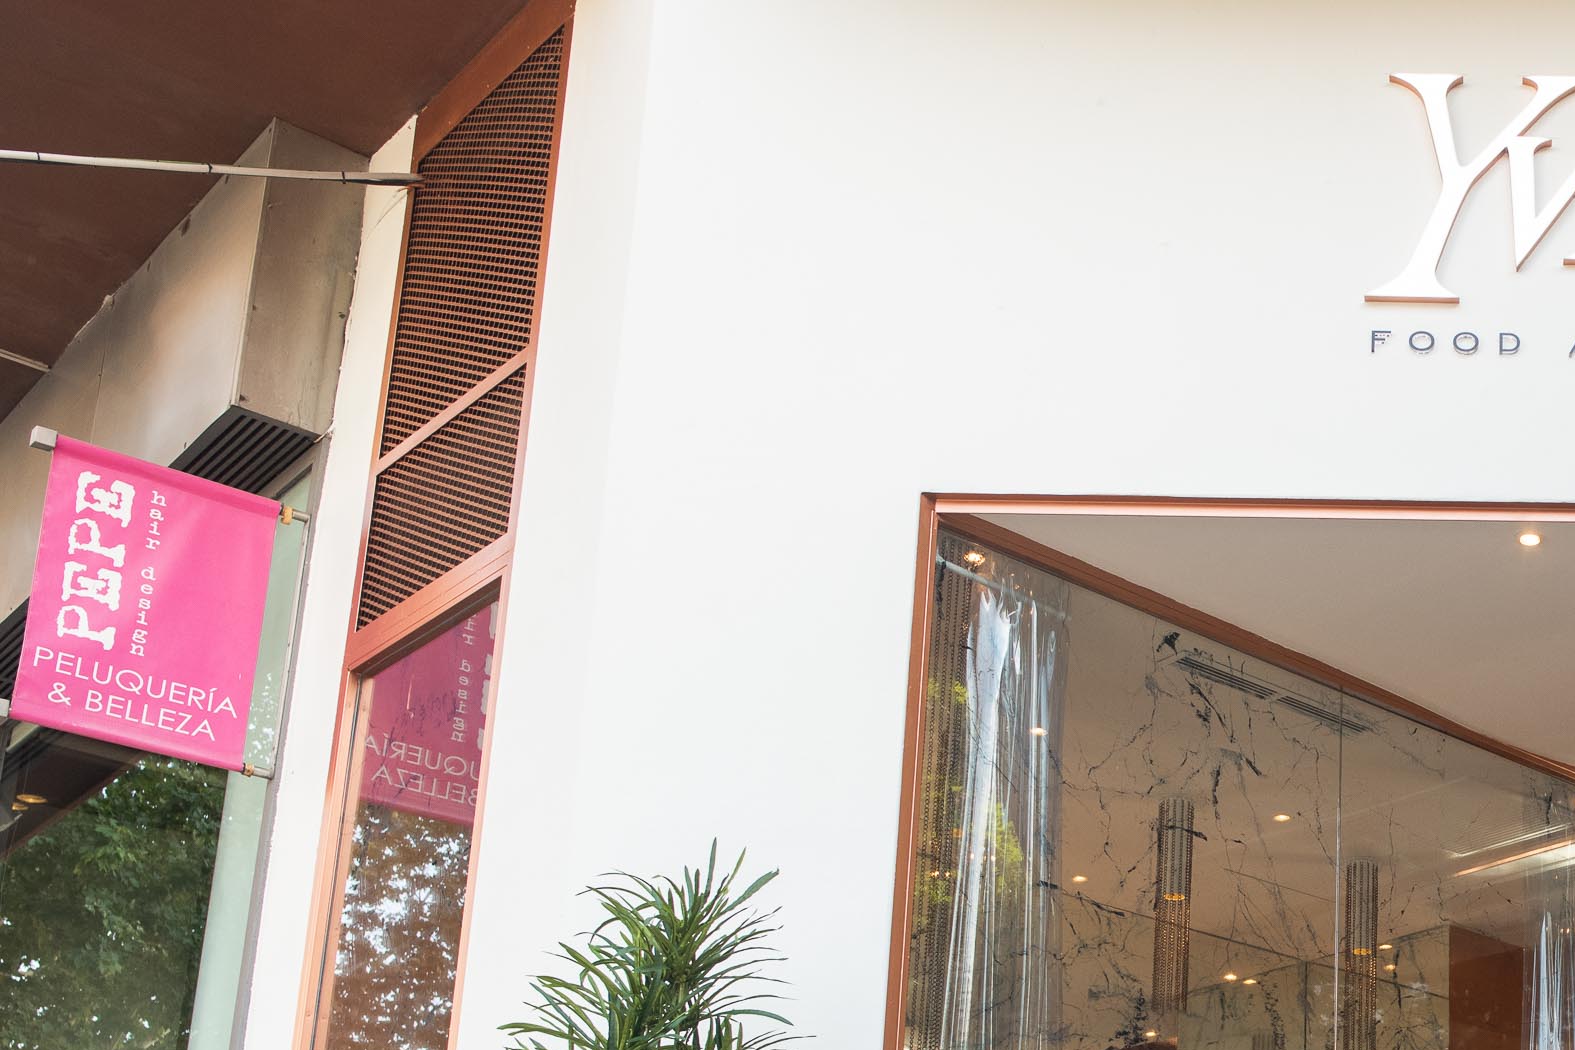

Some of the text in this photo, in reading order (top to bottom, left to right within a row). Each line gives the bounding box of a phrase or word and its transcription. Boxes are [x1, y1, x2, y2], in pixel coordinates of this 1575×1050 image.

[1371, 330, 1521, 356] FOOD
[56, 471, 136, 651] PEPE
[129, 490, 168, 657] hair design
[33, 646, 238, 718] PELUQUERÍA
[47, 682, 216, 741] & BELLEZA
